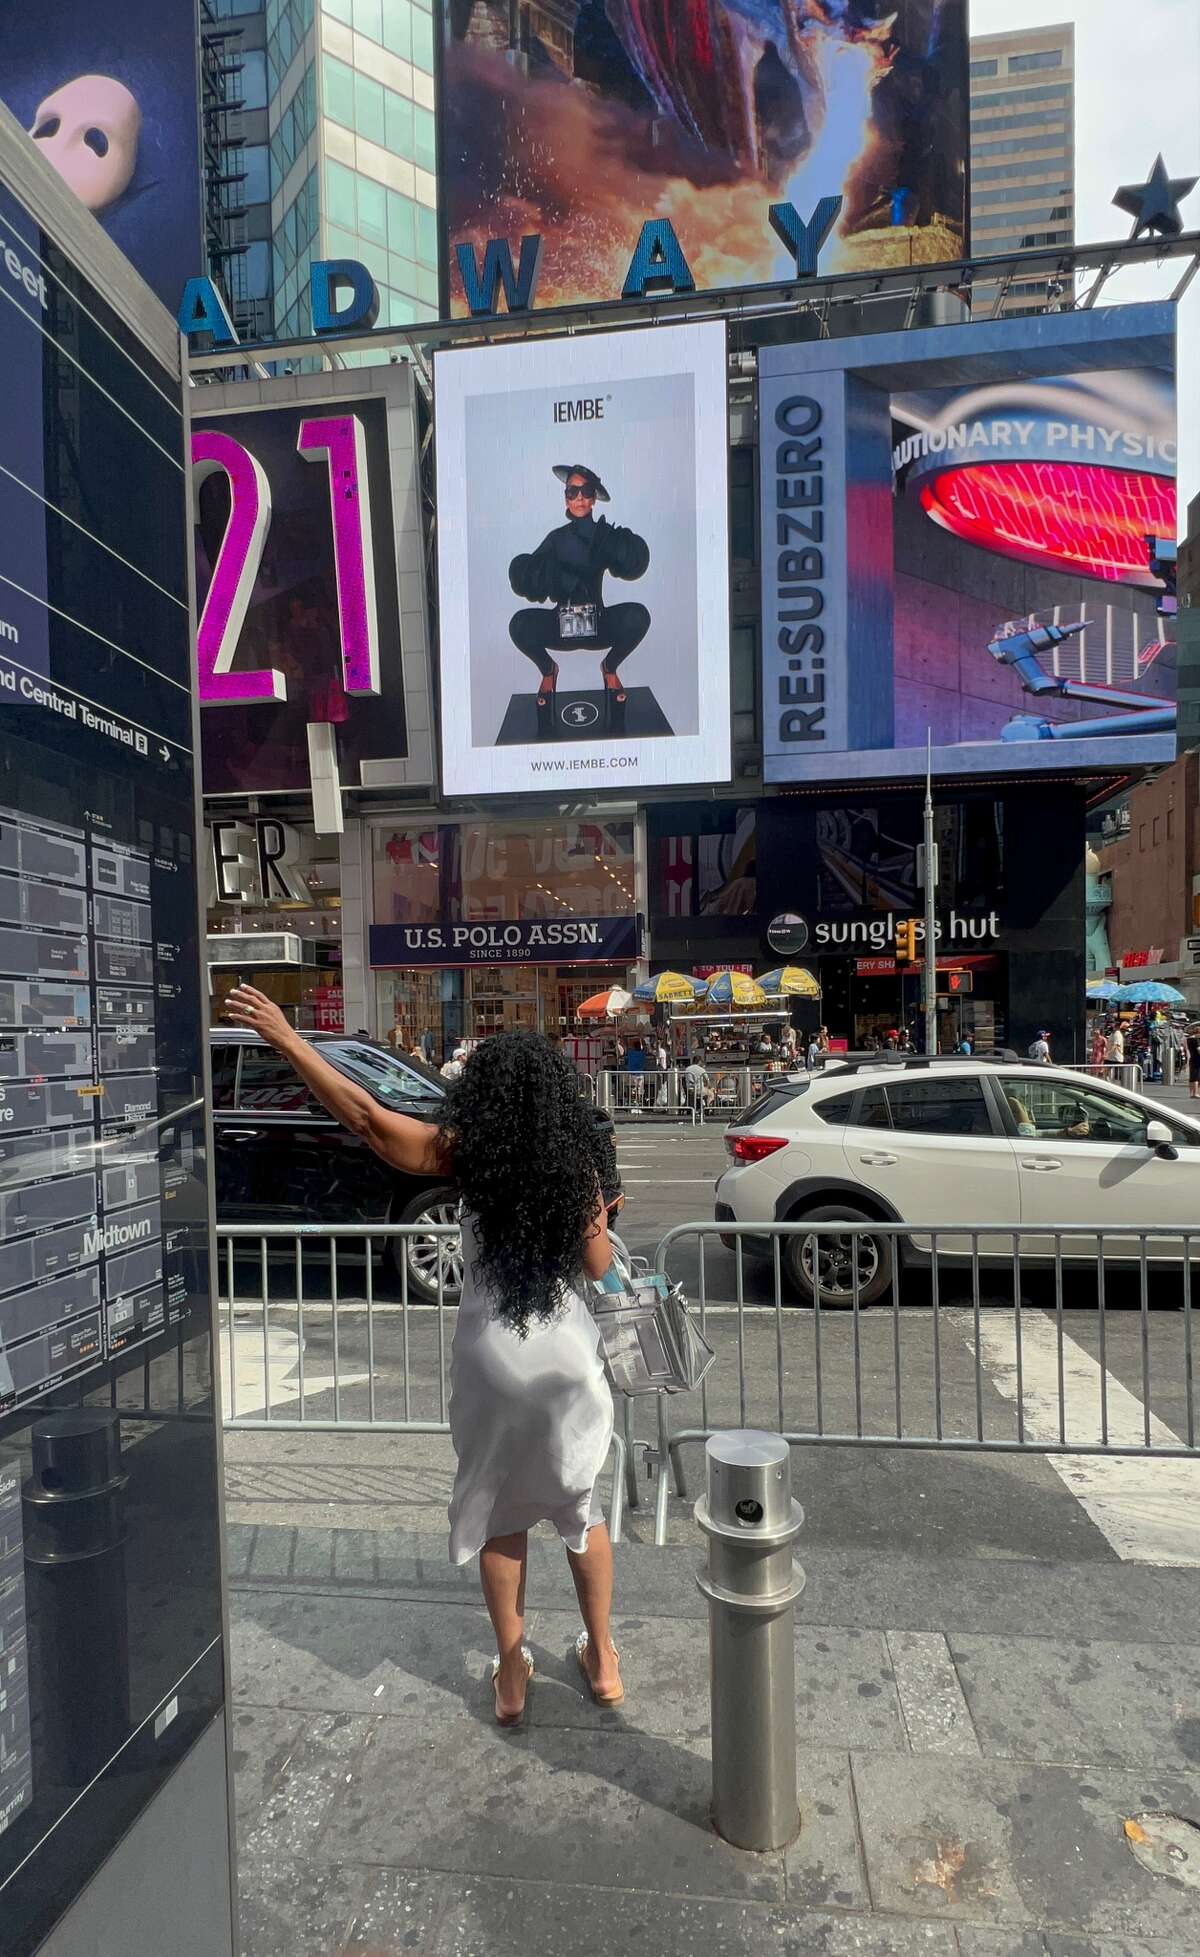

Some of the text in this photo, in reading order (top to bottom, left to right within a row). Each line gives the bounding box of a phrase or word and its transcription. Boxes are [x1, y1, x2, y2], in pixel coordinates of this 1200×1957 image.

[553, 398, 604, 423] IEMBE
[892, 420, 1035, 472] LUTIONARY
[191, 414, 382, 702] 21
[775, 395, 825, 742] RE:SUBZERO
[0, 620, 19, 643] m
[20, 676, 77, 720] Central
[79, 704, 134, 746] Terminal
[531, 757, 638, 772] WWW.IEMBE.COM
[210, 818, 306, 904] ER
[405, 923, 603, 948] U.S. POLO ASSN.
[815, 911, 1001, 950] sunglss hut
[470, 947, 531, 959] SINCE 1890
[83, 1218, 151, 1256] Midtown
